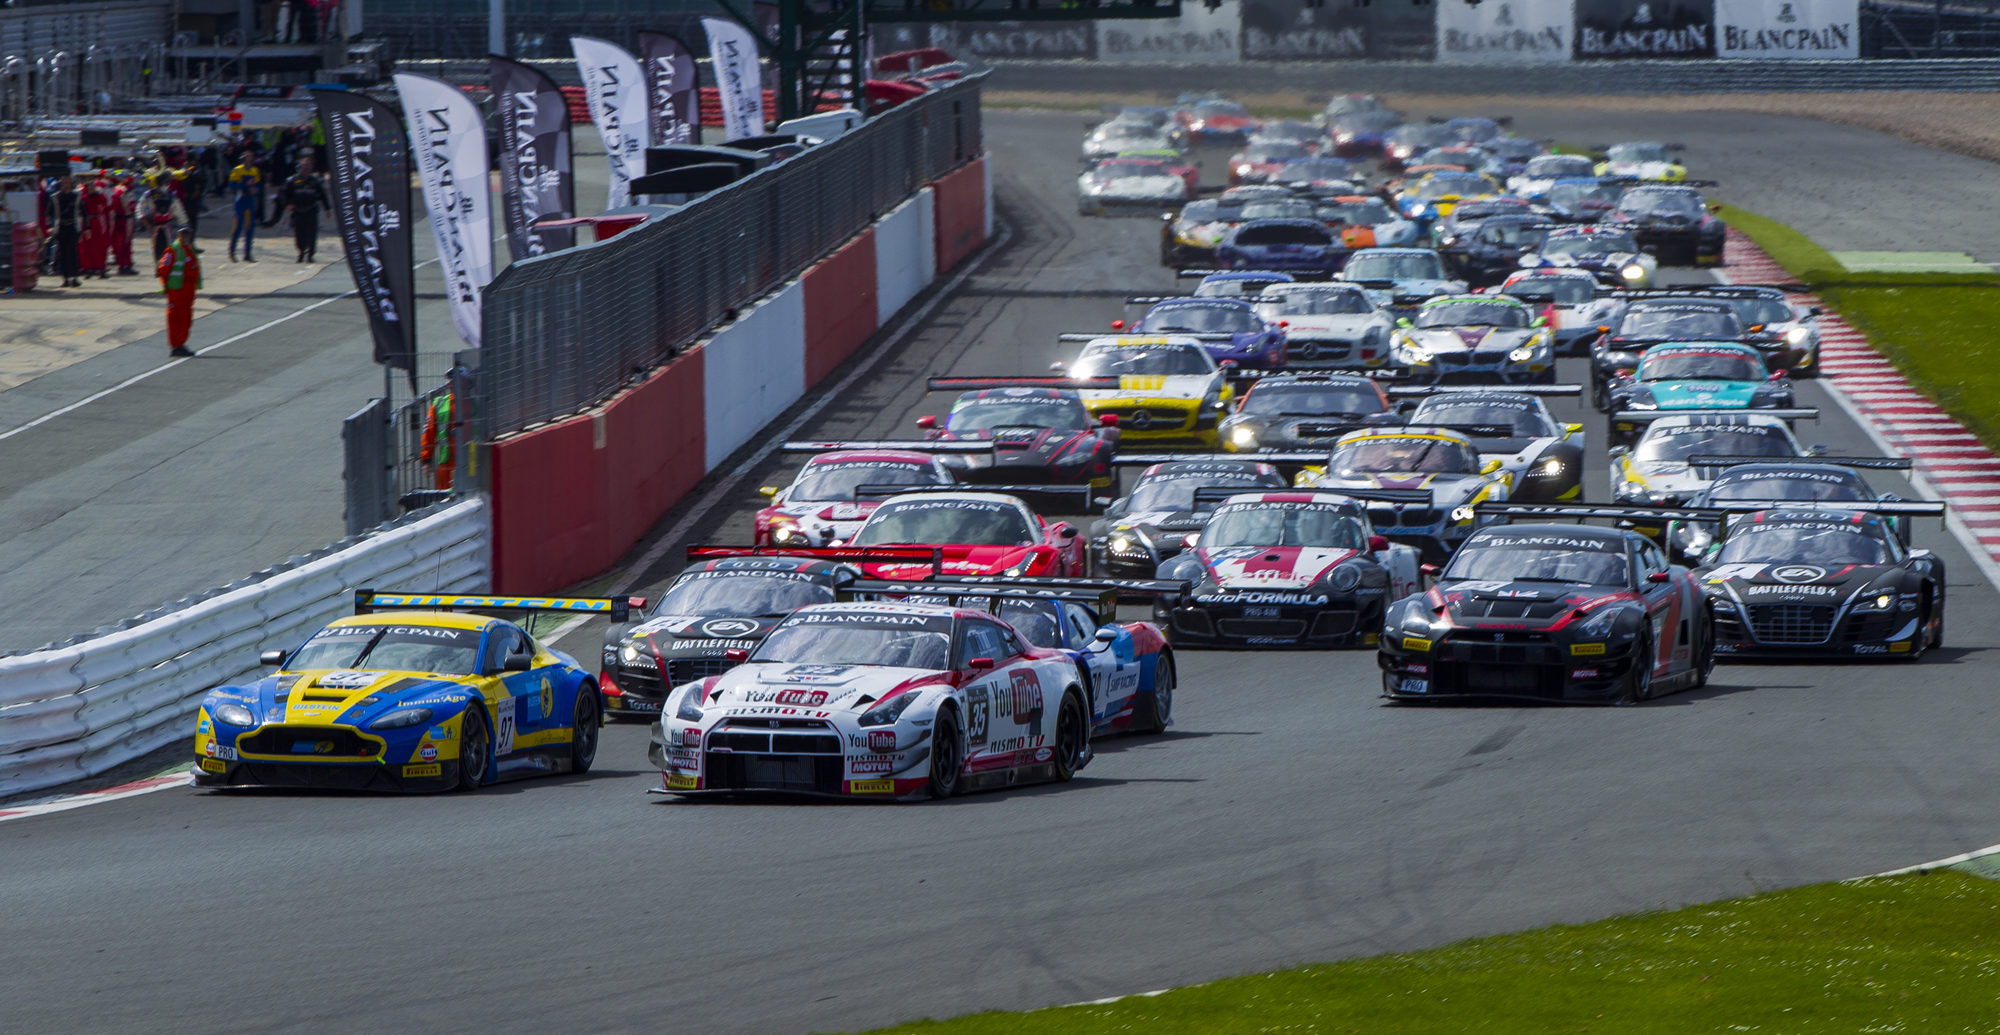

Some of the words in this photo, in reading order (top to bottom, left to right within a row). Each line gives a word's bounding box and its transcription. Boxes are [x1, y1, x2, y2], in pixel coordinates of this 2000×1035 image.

[1582, 23, 1707, 54] BLANCPAIN
[1723, 23, 1850, 53] BLANCPAIN
[1741, 472, 1843, 483] BLANCPAIN
[895, 501, 1002, 513] BLANCPAIN
[1230, 502, 1341, 513] BLANCPAIN
[1751, 522, 1863, 534] BLANCPAIN
[1489, 537, 1606, 550] BLANCPAIN
[697, 570, 814, 583] BLANCPAIN
[1748, 585, 1826, 596] BATTLEFIELD
[1826, 586, 1837, 597] 4
[1196, 592, 1329, 606] euroFORMULA
[801, 613, 929, 626] BLANCPAIN
[338, 627, 461, 640] BLANCPAIN
[672, 638, 754, 650] BATTLEFIELD
[1852, 644, 1889, 655] TOTAL
[1405, 680, 1423, 691] PRO
[991, 676, 1041, 719] YouTube
[292, 703, 342, 712] BILSTEIN
[970, 702, 986, 738] 35
[498, 716, 513, 750] 97
[671, 728, 701, 746] YouTube
[848, 732, 896, 749] YouTube
[218, 746, 233, 760] PRO
[672, 758, 697, 769] MOTUL
[852, 762, 892, 772] MOTUL
[406, 765, 438, 776] PIRELLI
[669, 776, 696, 787] PIRELLI
[854, 782, 891, 791] PIRELLI
